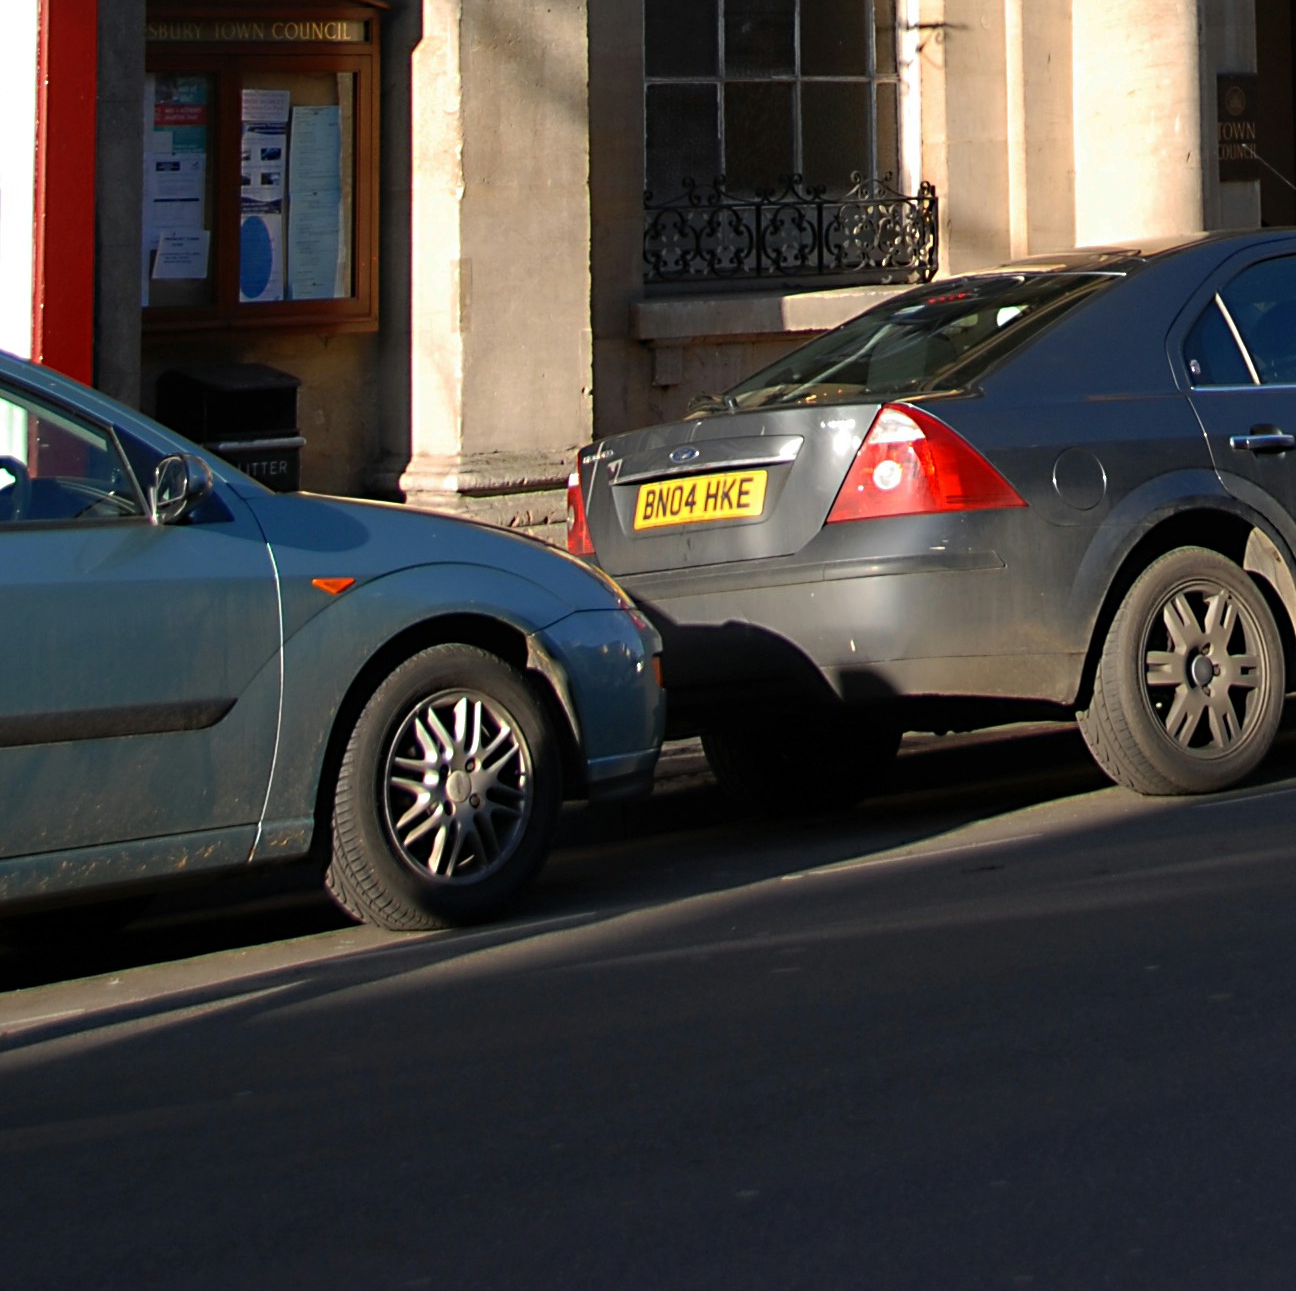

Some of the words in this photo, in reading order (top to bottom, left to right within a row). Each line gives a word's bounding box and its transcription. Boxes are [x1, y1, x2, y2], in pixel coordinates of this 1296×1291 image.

[147, 23, 201, 39] SBURY
[213, 23, 264, 40] TOWN
[271, 22, 351, 40] COUNCIL
[1218, 122, 1256, 140] TOWN
[643, 483, 696, 520] BN04
[704, 477, 753, 512] HKE
